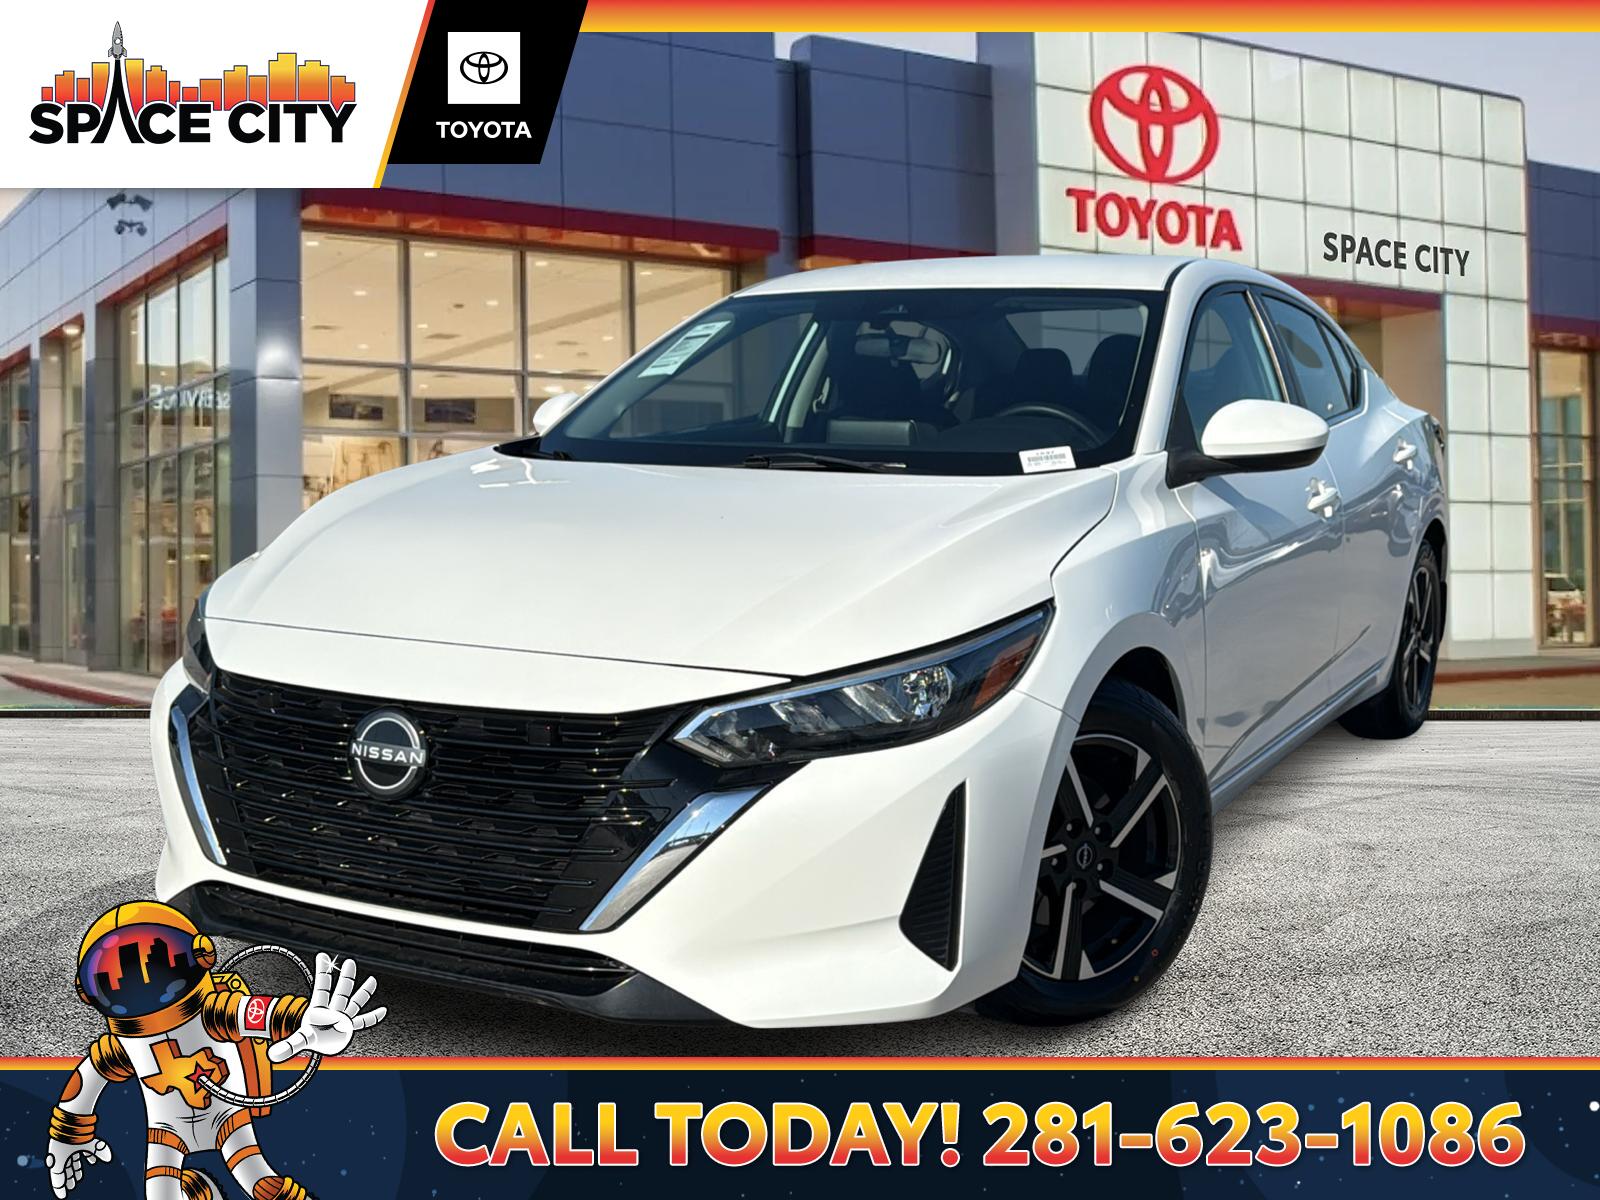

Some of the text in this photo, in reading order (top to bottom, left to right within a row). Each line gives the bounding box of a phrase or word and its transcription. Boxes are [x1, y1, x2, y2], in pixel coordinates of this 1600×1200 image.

[1066, 187, 1242, 251] TOYOTA
[1322, 232, 1470, 277] SPACE CITY
[351, 742, 424, 764] NISSAN
